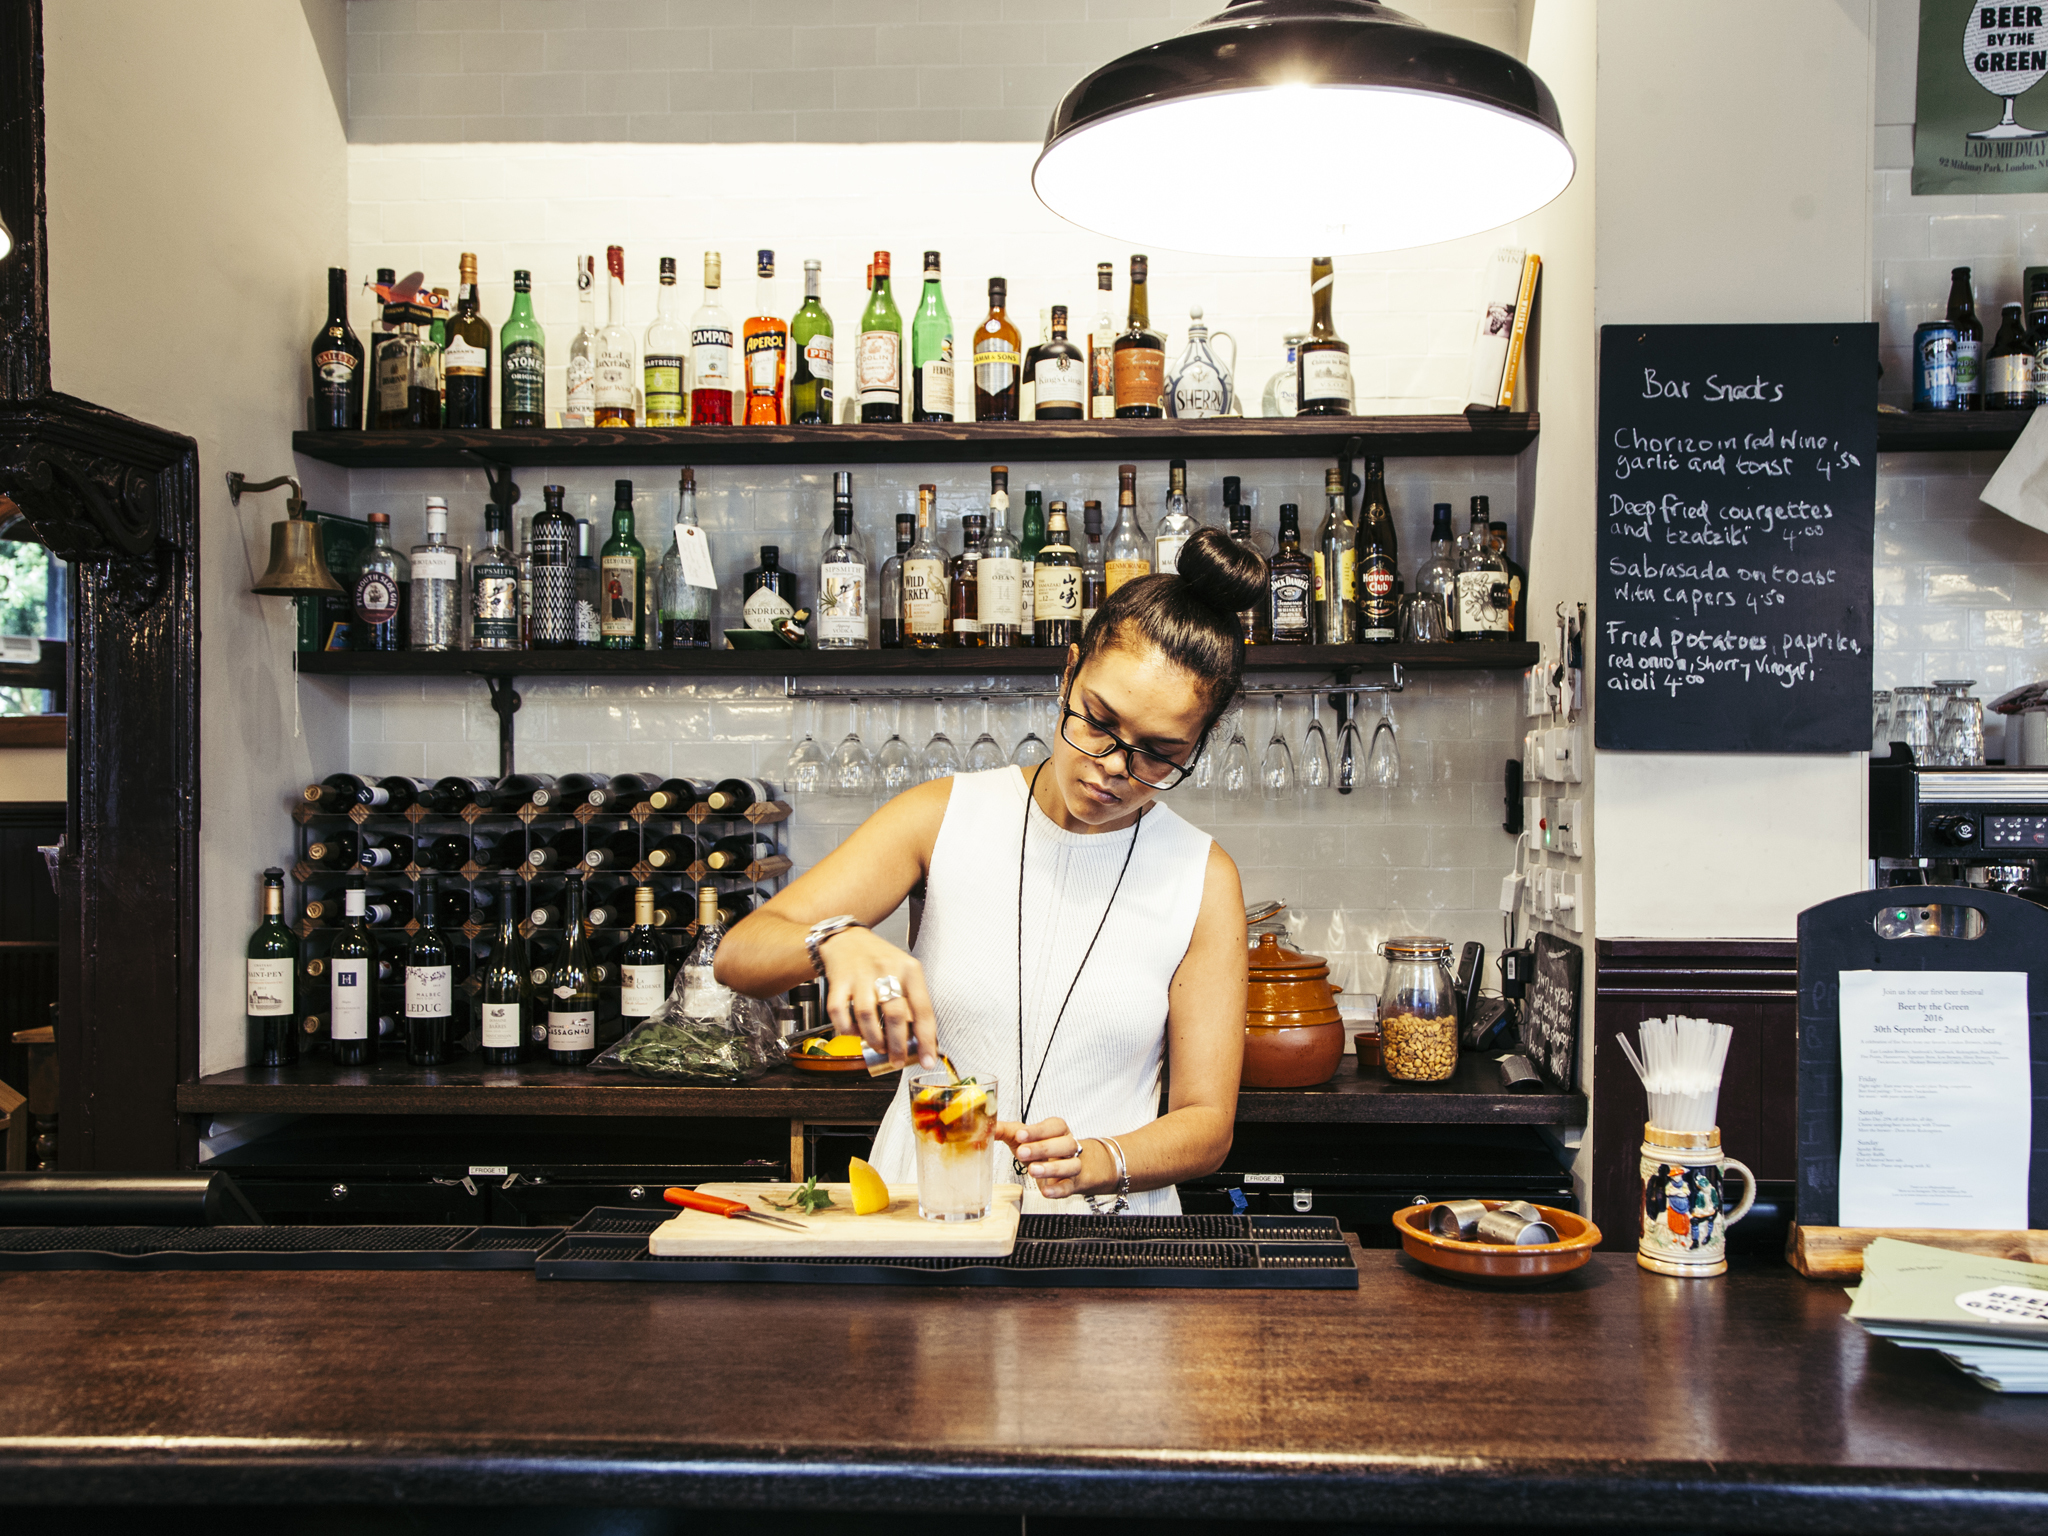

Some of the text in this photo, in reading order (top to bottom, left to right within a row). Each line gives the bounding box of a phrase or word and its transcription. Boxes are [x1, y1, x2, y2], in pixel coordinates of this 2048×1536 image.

[1980, 6, 2043, 29] BEER
[1987, 32, 2035, 47] BY THE
[1974, 51, 2047, 72] GREEN
[1995, 140, 2046, 158] MILDMAY
[1939, 157, 2037, 174] 92 Mildmay Park, London,
[1516, 299, 1529, 335] WHISKY
[746, 335, 784, 353] APEROL
[315, 351, 357, 367] BAILEYS
[809, 348, 833, 360] PER
[862, 354, 889, 362] DOLIN
[997, 354, 1017, 362] SONS
[1642, 368, 1784, 402] Bar Snacks
[1177, 390, 1222, 411] SHERRY
[1614, 427, 1713, 453] Chorizo
[1717, 439, 1737, 450] in
[1744, 428, 1775, 450] red
[1615, 453, 1679, 479] garlic
[1688, 454, 1726, 475] and
[1736, 458, 1793, 476] toast
[1609, 493, 1833, 533] Deep fried courgettes
[1610, 521, 1652, 542] and
[825, 566, 862, 574] SIPSMITH
[1106, 562, 1148, 570] GLENMORANGIE
[1609, 553, 1836, 586] Sabrasada on toast
[905, 576, 924, 588] WILD
[1271, 575, 1309, 591] JACK DANIEL'S
[1363, 573, 1394, 583] Havana
[356, 573, 379, 606] PLYMOUTH
[380, 575, 395, 592] SLOE
[997, 586, 1010, 600] 14
[1368, 582, 1389, 591] Club
[1664, 588, 1736, 616] capers
[744, 607, 791, 616] HENDRICK'S
[1606, 621, 1662, 649] Fried
[1608, 653, 1634, 668] red
[1607, 670, 1656, 691] aioli
[1882, 988, 1897, 996] Join
[1907, 988, 1917, 996] for
[1930, 988, 1943, 996] first
[1944, 988, 1959, 996] beer
[1960, 988, 1984, 996] festival
[1897, 1002, 1970, 1013] Beer by the Green
[1923, 1014, 1944, 1022] 2016
[1873, 1025, 1892, 1034] 30th
[1893, 1025, 1937, 1036] September
[1944, 1025, 1960, 1034] 2nd
[1961, 1025, 1996, 1034] October
[1858, 1076, 1877, 1084] Friday
